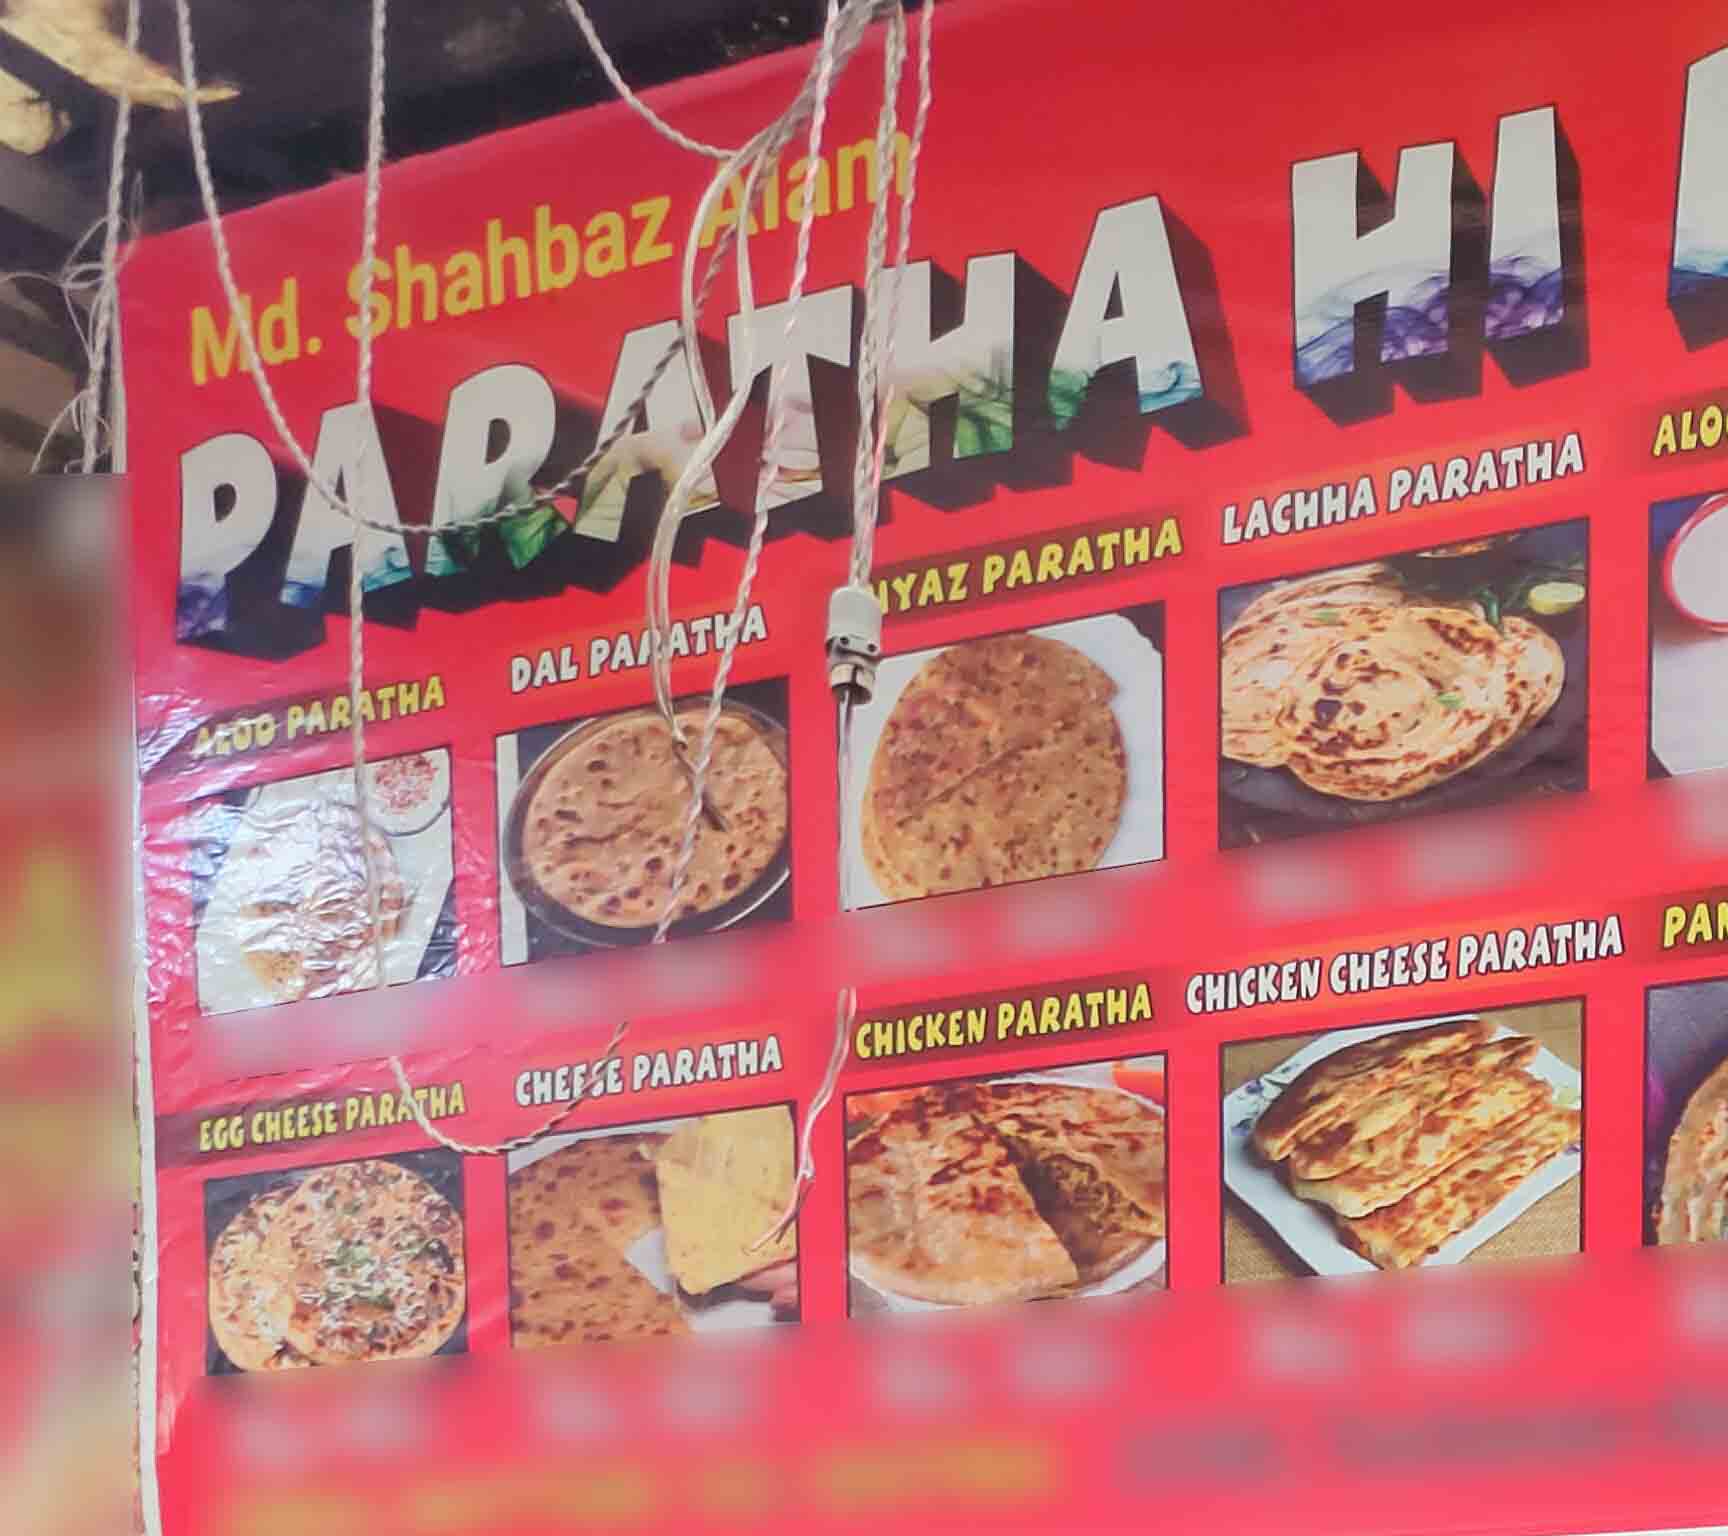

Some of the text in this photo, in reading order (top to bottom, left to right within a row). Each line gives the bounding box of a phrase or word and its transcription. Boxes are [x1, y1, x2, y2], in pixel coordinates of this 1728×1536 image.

[191, 130, 915, 386] Md. Shahbaz Alam
[177, 194, 1201, 642] PARATHA
[1290, 104, 1567, 388] HI
[1222, 432, 1585, 545] LACHHA PARATHA
[866, 518, 1183, 616] IYAZ PARATHA
[510, 604, 767, 693] DAL PARATHA
[287, 675, 446, 740] PARATHA
[1186, 914, 1624, 1014] CHICKEN CHEESE PARATHA
[855, 983, 1152, 1059] CHICKEN PARATHA
[199, 1082, 465, 1152] EGG CHEESE PARATHA
[514, 1035, 783, 1106] CHEESE PARATHA
